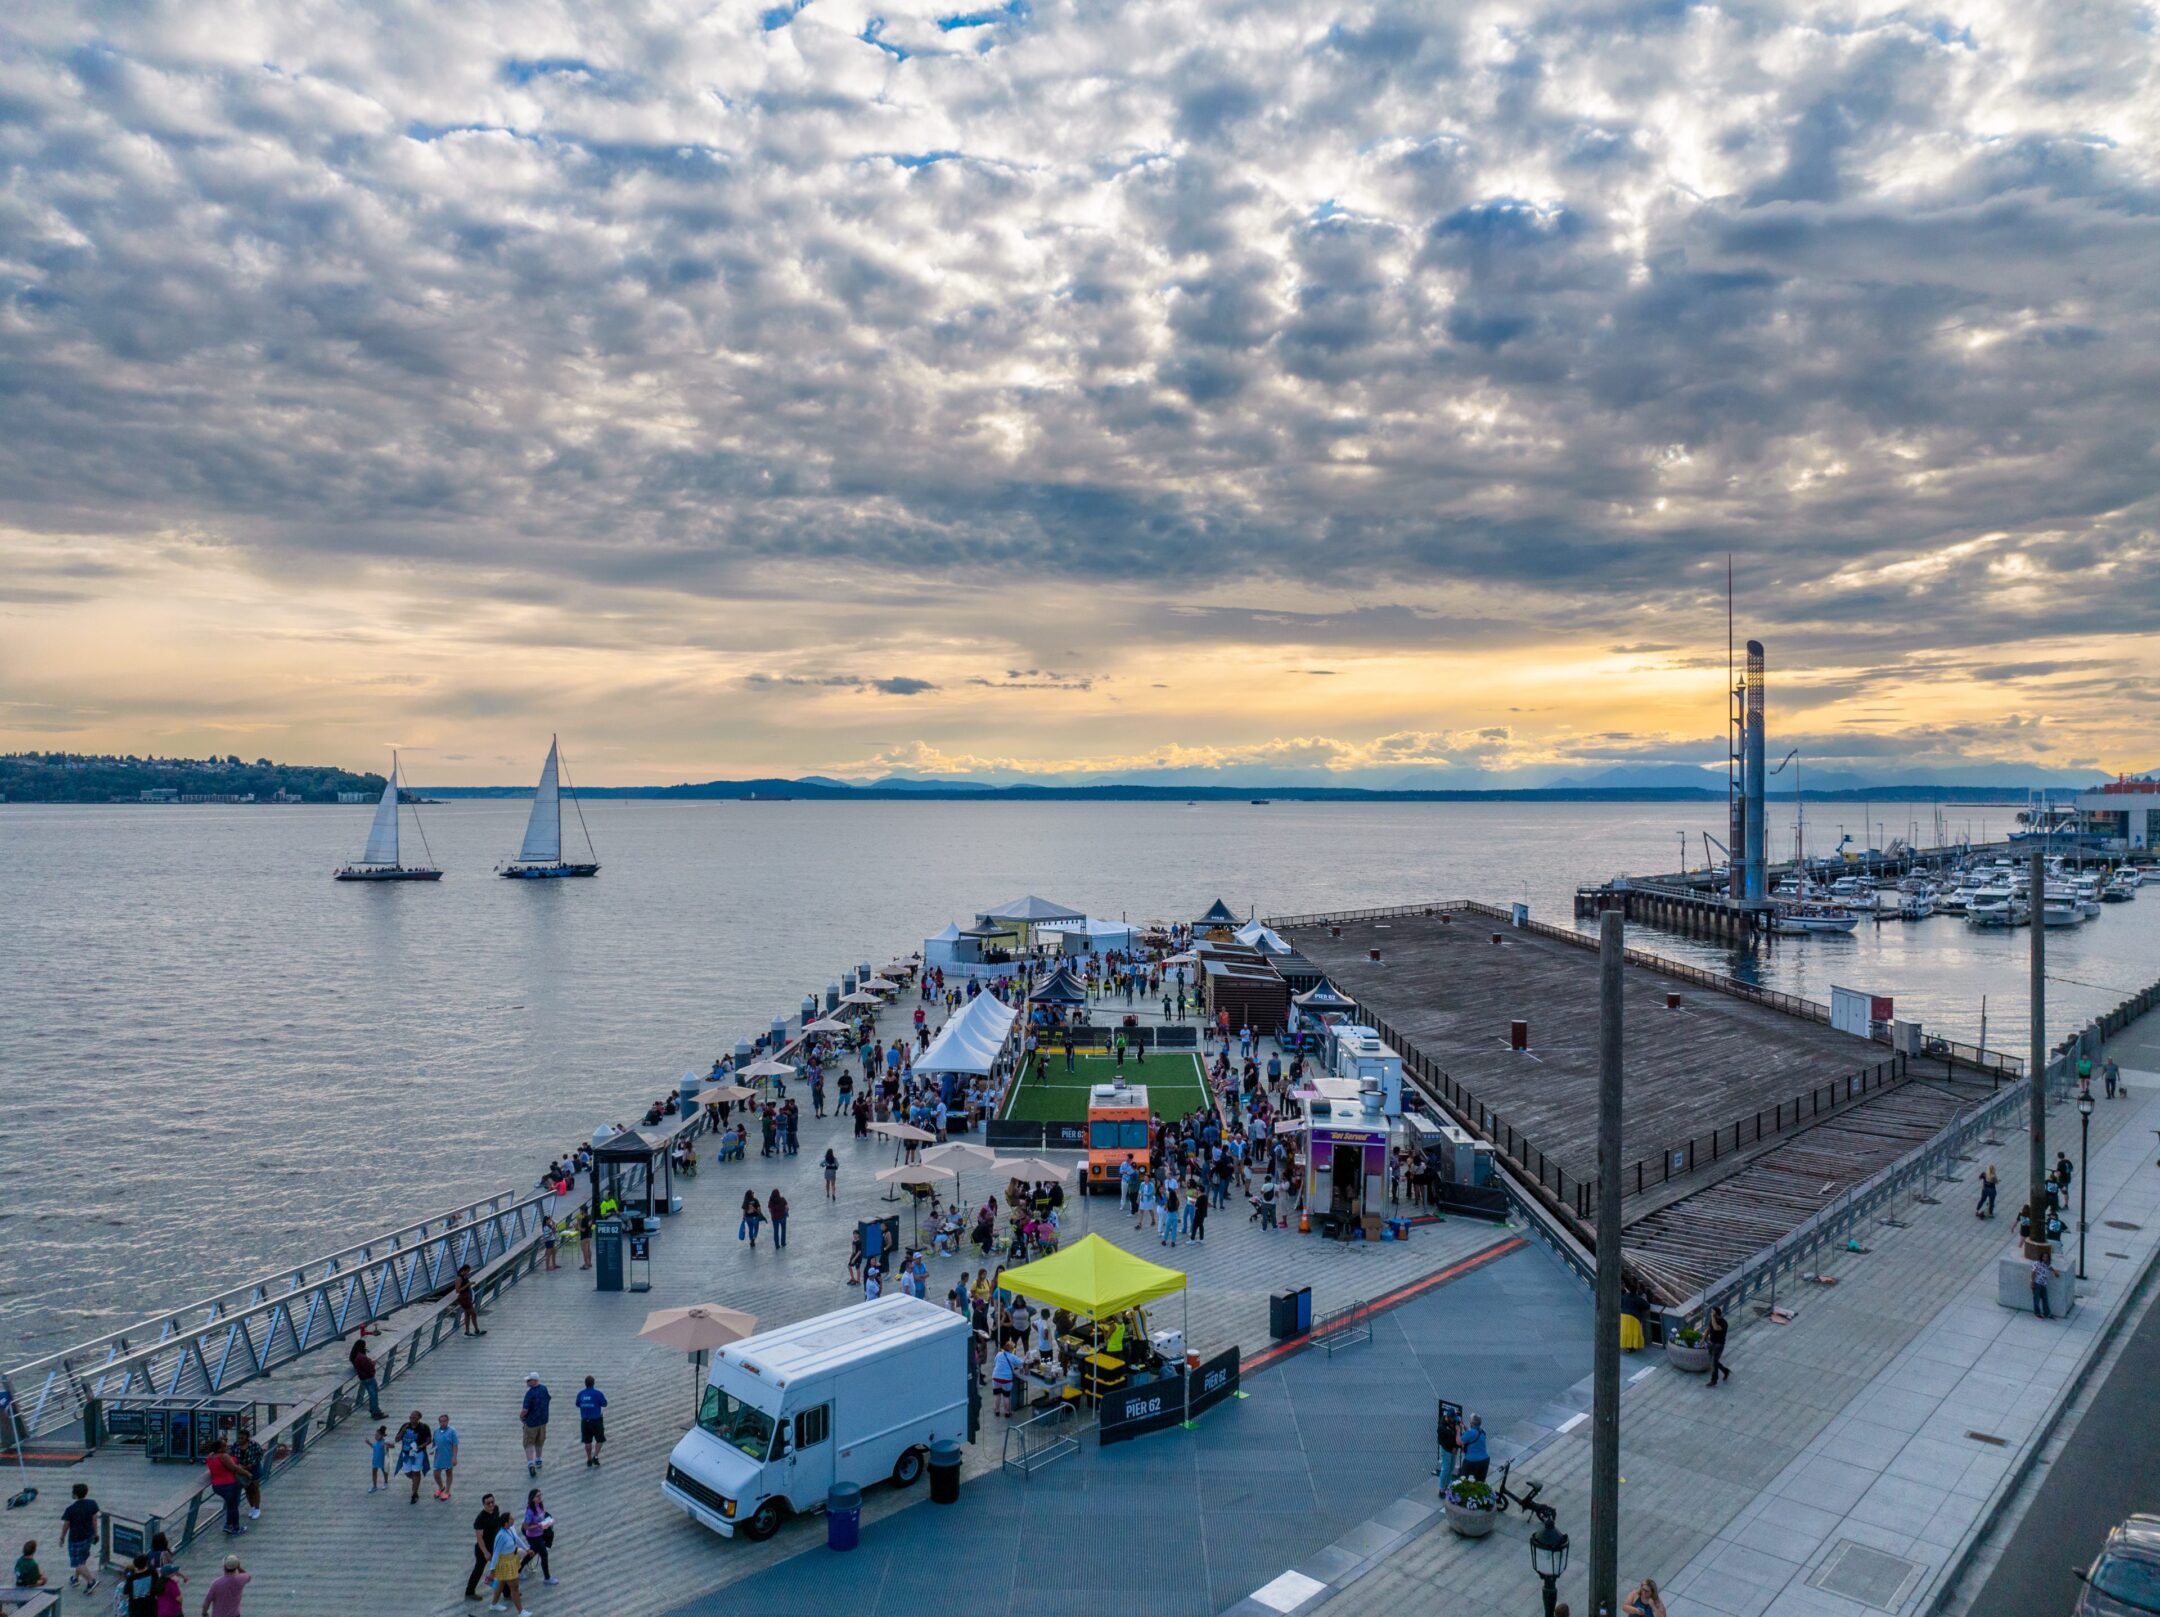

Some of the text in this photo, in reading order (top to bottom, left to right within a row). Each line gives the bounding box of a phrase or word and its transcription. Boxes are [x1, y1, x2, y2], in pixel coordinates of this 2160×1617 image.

[1061, 1130, 1076, 1138] PIER
[597, 1226, 619, 1234] PIER 62
[1204, 1373, 1219, 1392] PIER
[1218, 1368, 1227, 1383] 62
[1126, 1401, 1148, 1419] PIER
[1148, 1397, 1161, 1412] 62
